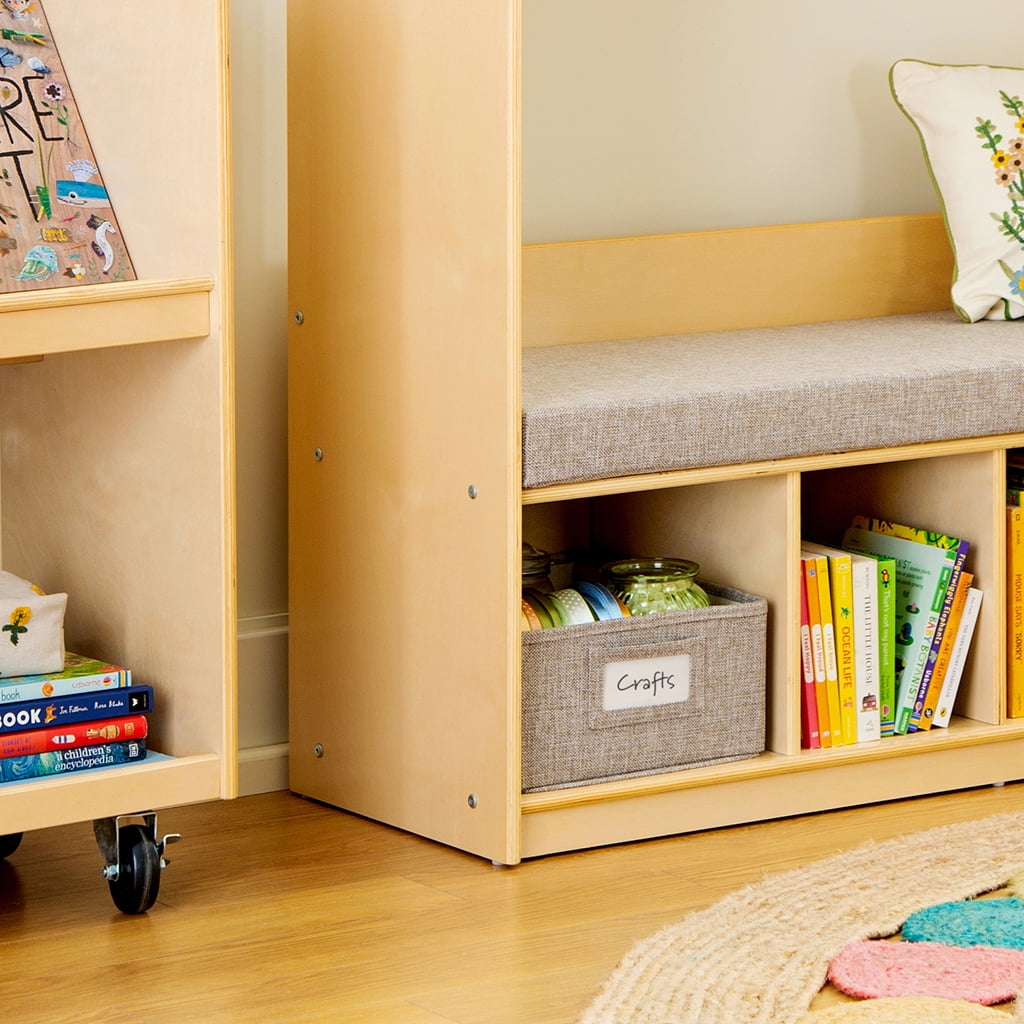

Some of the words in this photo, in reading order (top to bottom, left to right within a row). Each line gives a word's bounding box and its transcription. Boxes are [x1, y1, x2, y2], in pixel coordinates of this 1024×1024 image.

[0, 76, 64, 144] RE
[944, 554, 966, 604] Fingerwiggly
[1015, 574, 1023, 603] MOUSE
[882, 589, 891, 612] That's
[864, 616, 872, 650] LITTLE
[881, 629, 889, 641] my
[924, 616, 938, 643] BABY
[935, 606, 951, 644] Elephants
[841, 626, 851, 664] OCEAN
[616, 670, 676, 696] Crafts
[843, 668, 852, 689] LIFE
[908, 645, 929, 702] BOTANIST
[919, 670, 932, 698] Usborne
[0, 691, 20, 702] book
[0, 708, 42, 728] OOK
[54, 754, 114, 771] encyclopedia
[64, 745, 112, 760] children's
